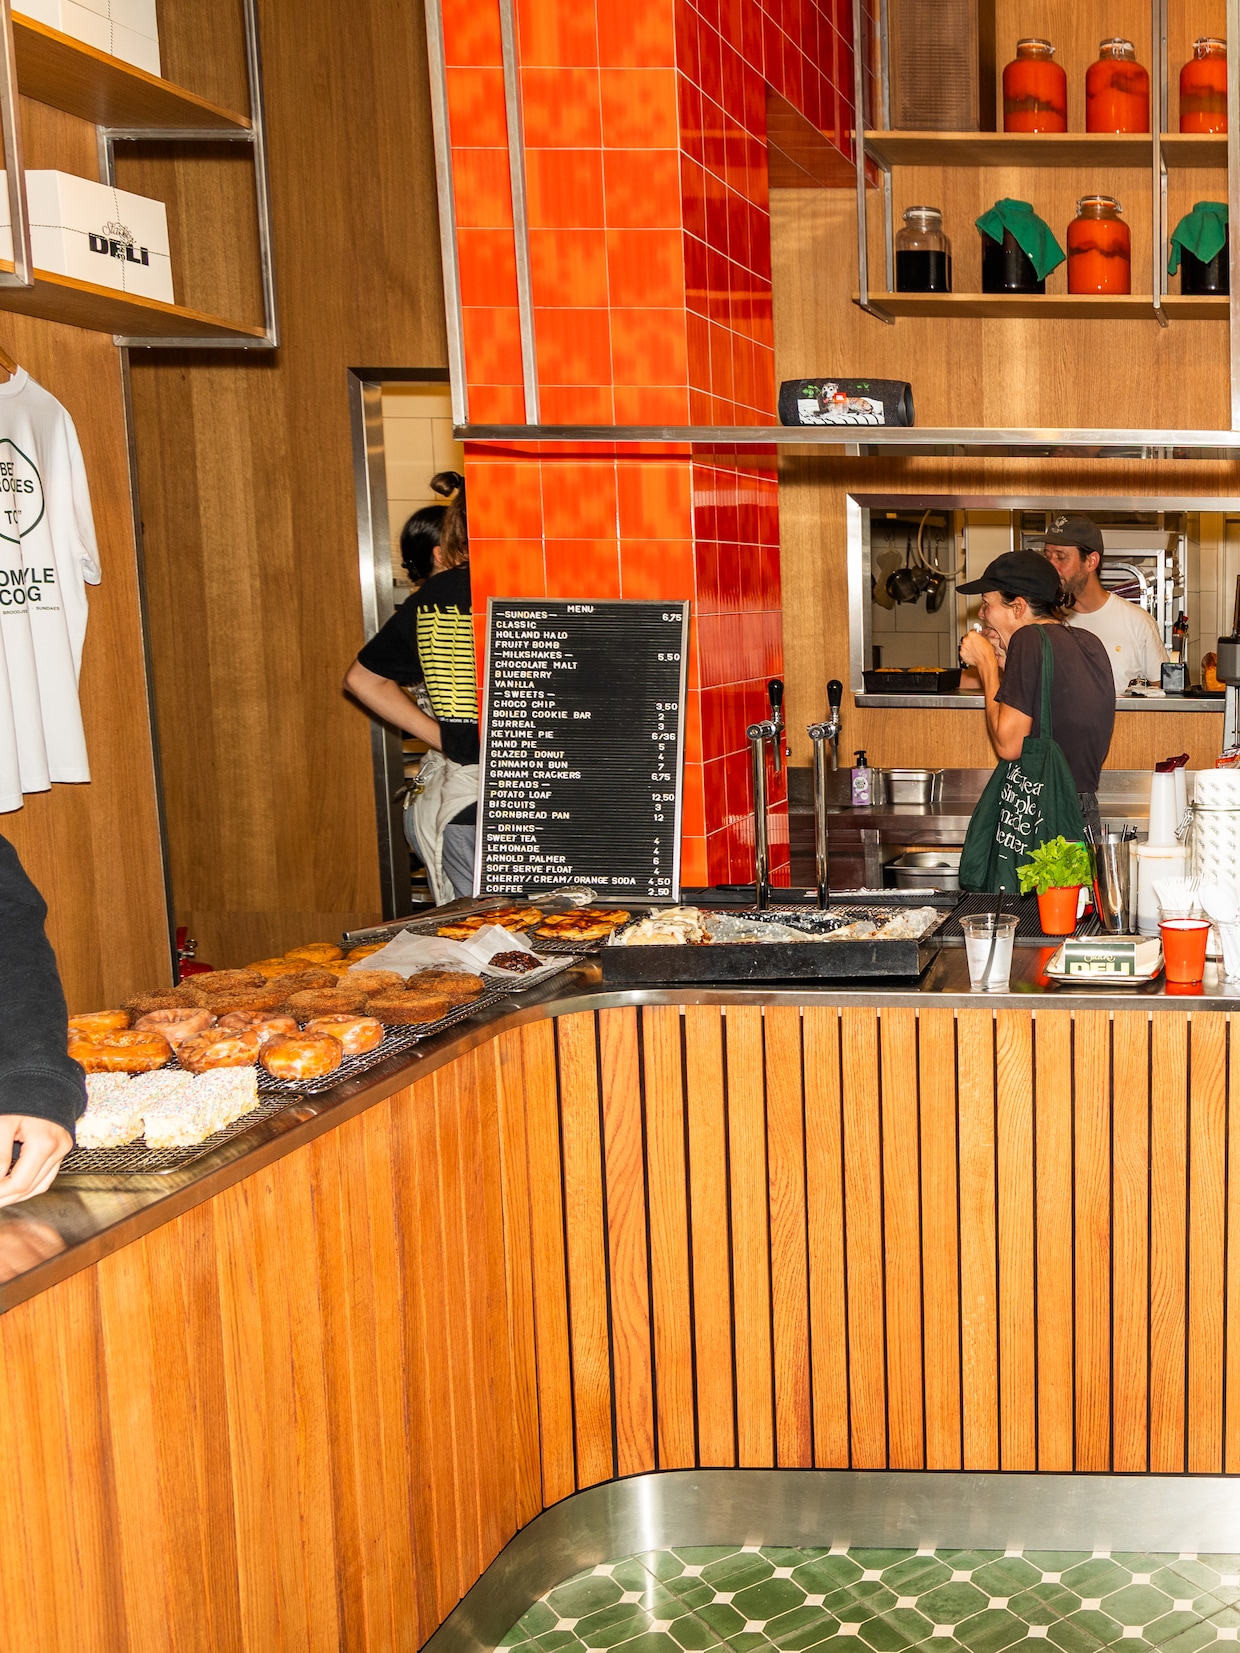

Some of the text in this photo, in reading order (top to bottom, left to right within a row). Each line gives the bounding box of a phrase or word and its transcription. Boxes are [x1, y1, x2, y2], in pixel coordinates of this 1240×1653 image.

[496, 621, 536, 629] CLASSIC
[496, 631, 540, 639] HOLLAND
[532, 641, 559, 649] BOMB
[657, 653, 680, 661] 5.50
[494, 700, 526, 708] CHOCO
[656, 703, 678, 712] 3.50
[492, 720, 536, 728] SURREAL
[491, 730, 533, 738] KEYLIME
[491, 750, 527, 758] GLAZED
[491, 760, 543, 768] CINNAMON
[490, 770, 671, 782] GRAHAM CRACKERS 6.75
[651, 794, 675, 802] 12.50
[489, 800, 535, 808] BISCUITS
[489, 811, 547, 819] CORNBREAD
[487, 834, 516, 842] SWEET
[488, 844, 539, 852] LEMONADE
[530, 855, 565, 863] PALMER
[487, 864, 509, 872] SOFT
[513, 865, 543, 873] SERVE
[647, 878, 671, 886] 4.50
[647, 888, 670, 896] 2.50
